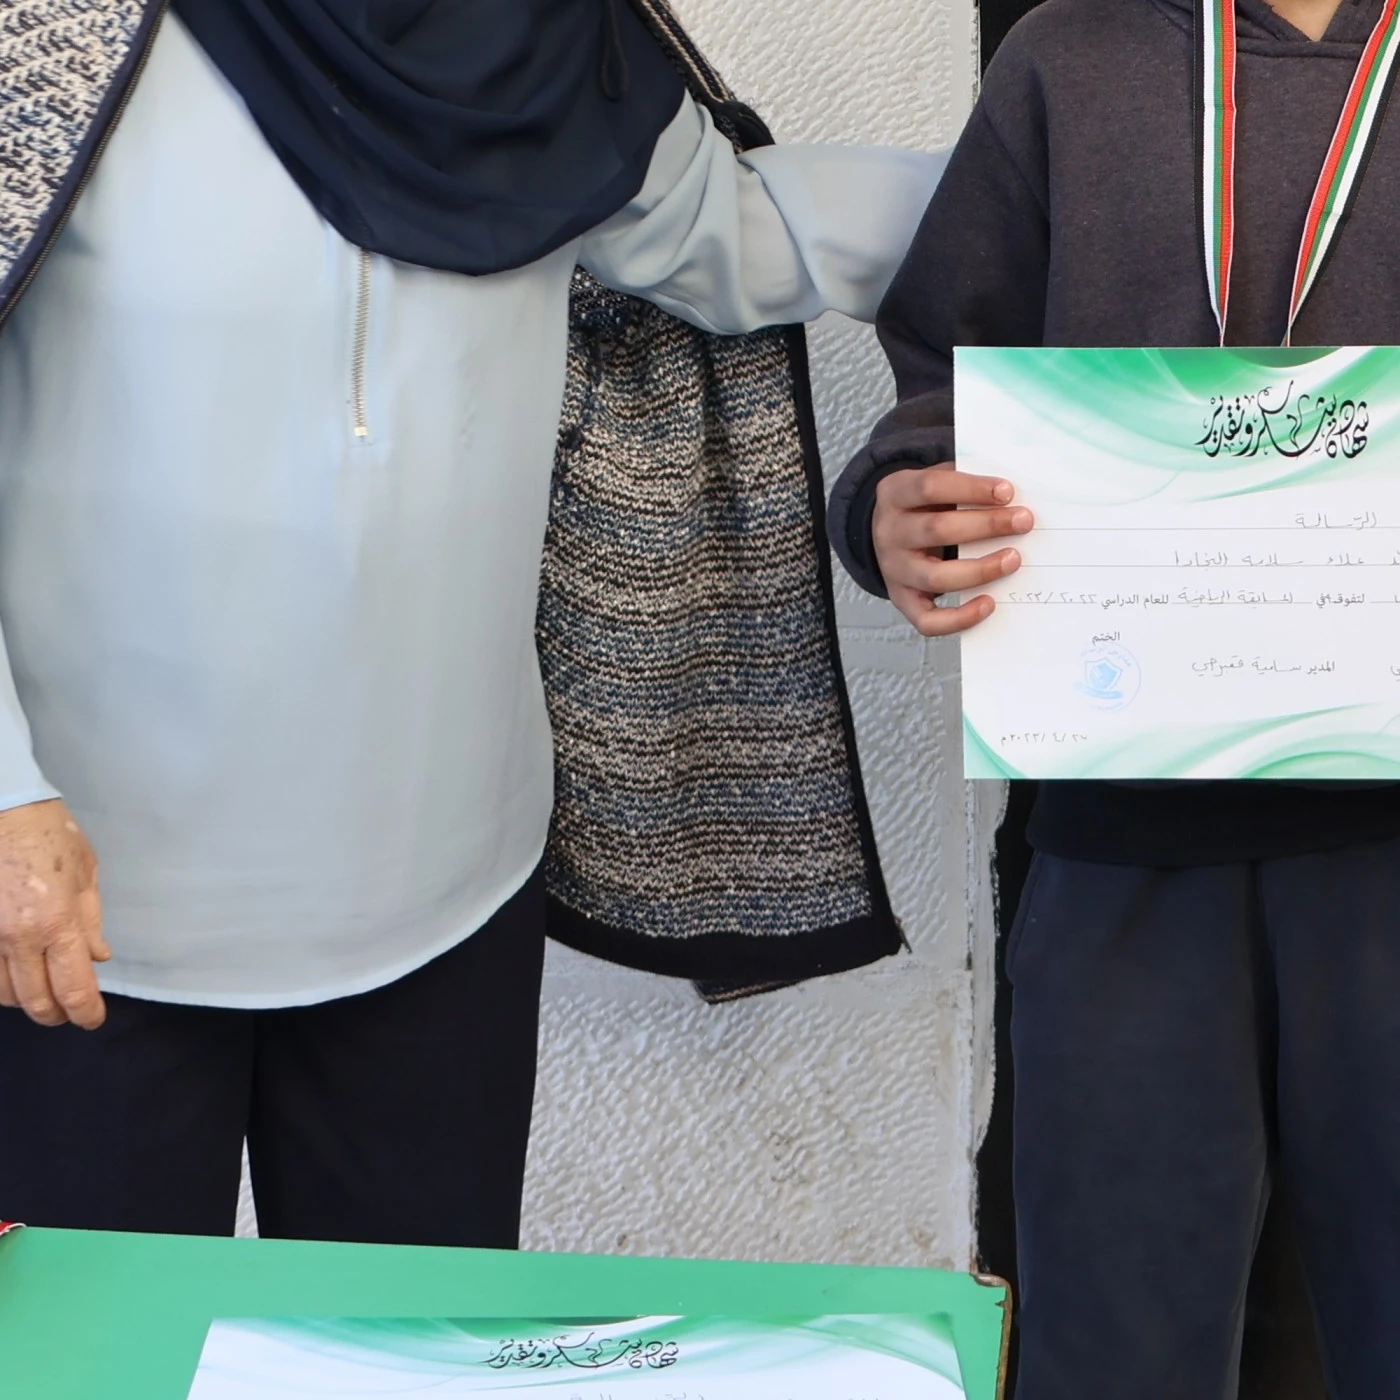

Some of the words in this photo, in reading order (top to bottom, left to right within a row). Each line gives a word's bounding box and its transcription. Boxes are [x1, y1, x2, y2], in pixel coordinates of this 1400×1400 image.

[1245, 379, 1337, 459] شكر
[1321, 398, 1370, 459] شهادة
[1101, 593, 1140, 610] الدراسي
[1143, 593, 1169, 608] للعام
[1091, 630, 1121, 647] الختم
[1306, 660, 1336, 675] المدير
